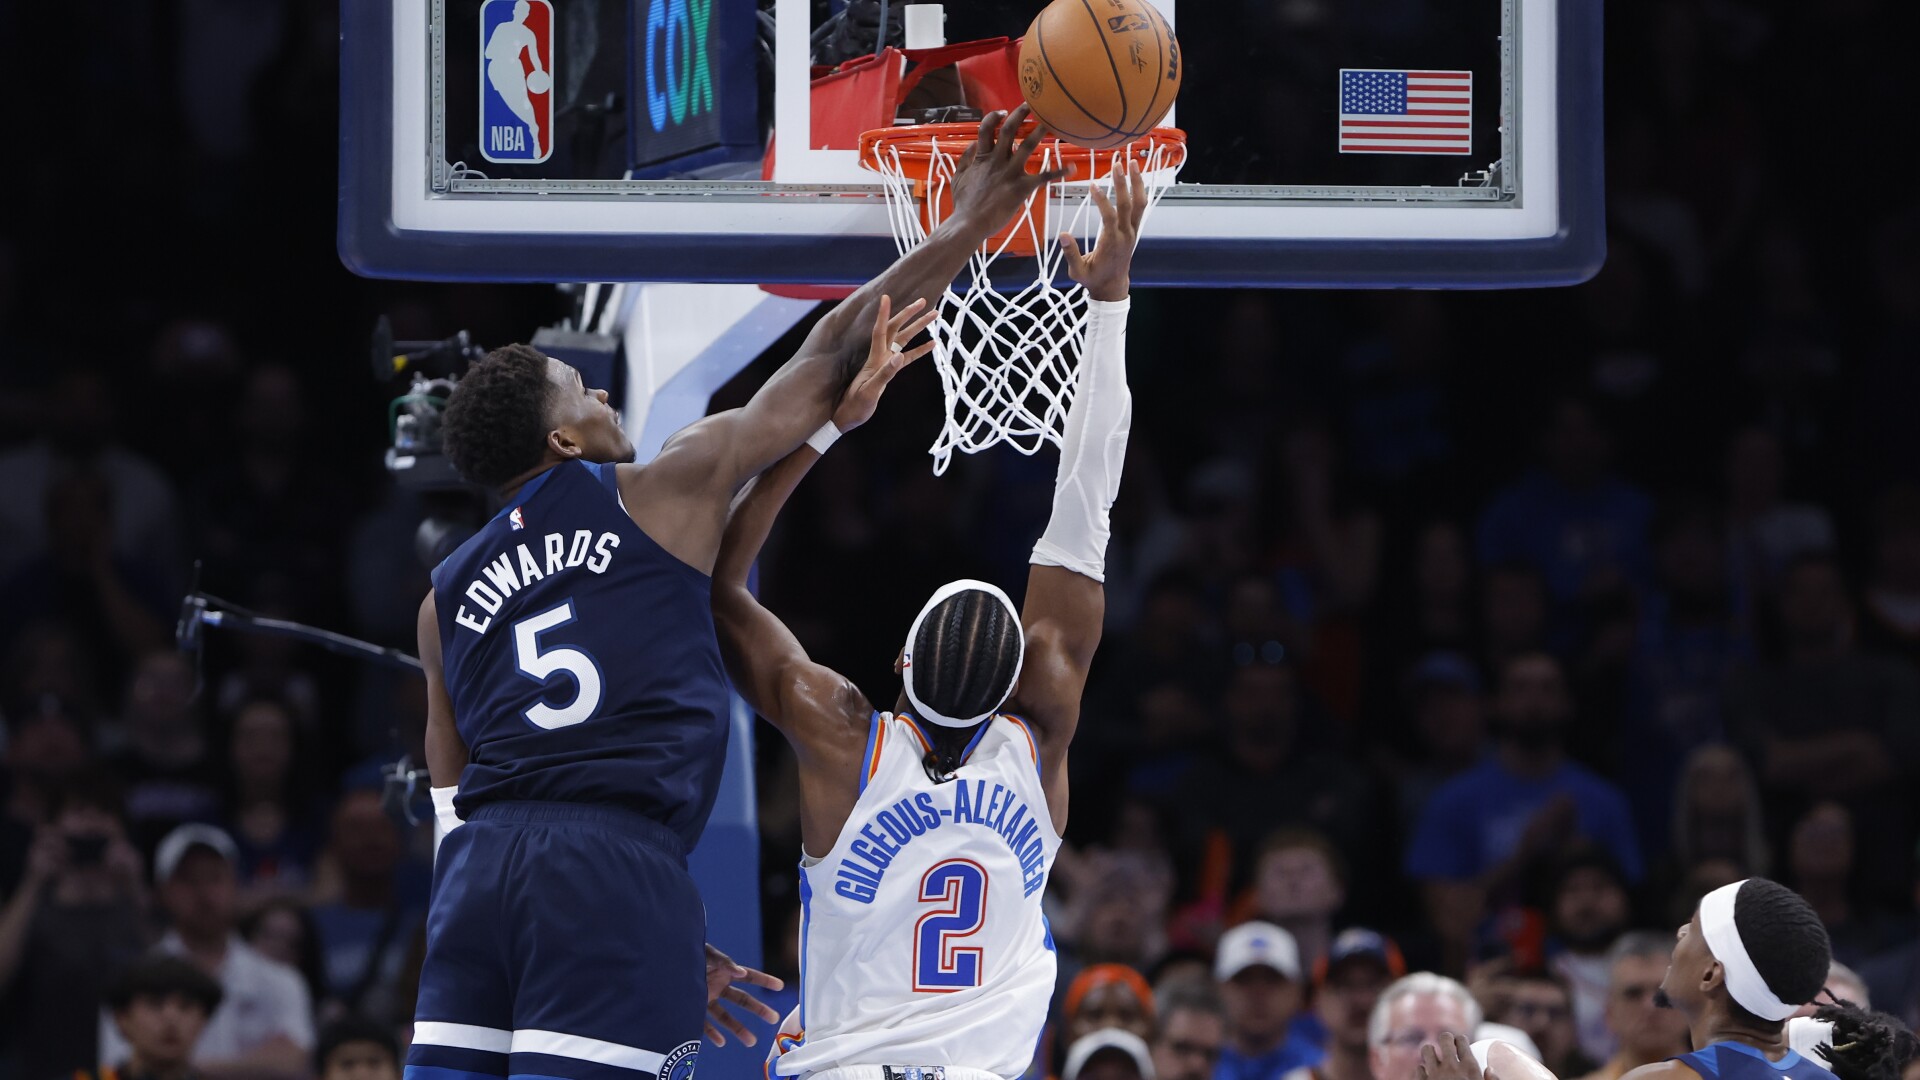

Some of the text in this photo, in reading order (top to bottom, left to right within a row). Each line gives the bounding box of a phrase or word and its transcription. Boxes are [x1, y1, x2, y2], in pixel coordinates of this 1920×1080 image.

[645, 0, 712, 133] COX
[491, 125, 525, 152] NBA
[455, 529, 621, 635] EDWARDS
[513, 601, 603, 731] 5
[834, 779, 1045, 905] GILGEOUS-ALEXANDER
[913, 858, 989, 993] 2
